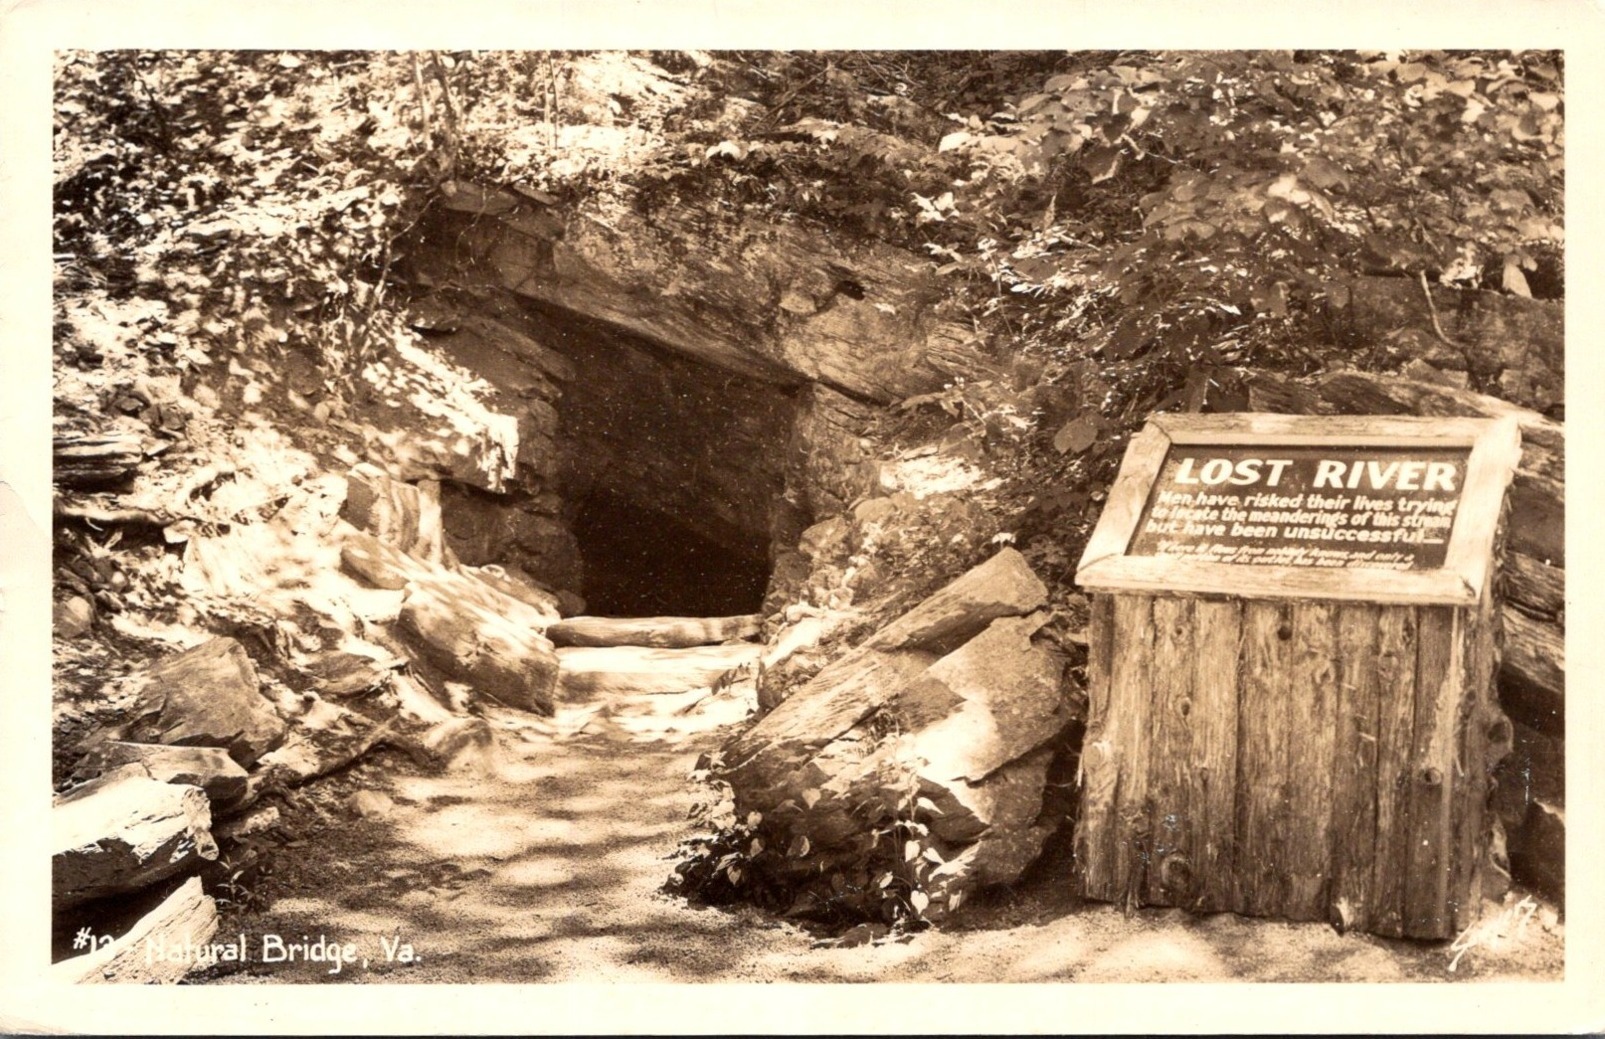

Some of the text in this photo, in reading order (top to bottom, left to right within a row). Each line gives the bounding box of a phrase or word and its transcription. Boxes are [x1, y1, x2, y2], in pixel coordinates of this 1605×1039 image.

[1175, 458, 1457, 491] LOST RIVER
[1158, 490, 1458, 516] Men have risked their lives trying
[1145, 518, 1179, 534] but
[1183, 520, 1226, 537] have
[1230, 522, 1279, 538] been
[1151, 505, 1169, 519] to
[1221, 507, 1248, 522] the
[1248, 509, 1349, 528] meanderings
[1350, 511, 1373, 526] of
[1372, 511, 1400, 527] this
